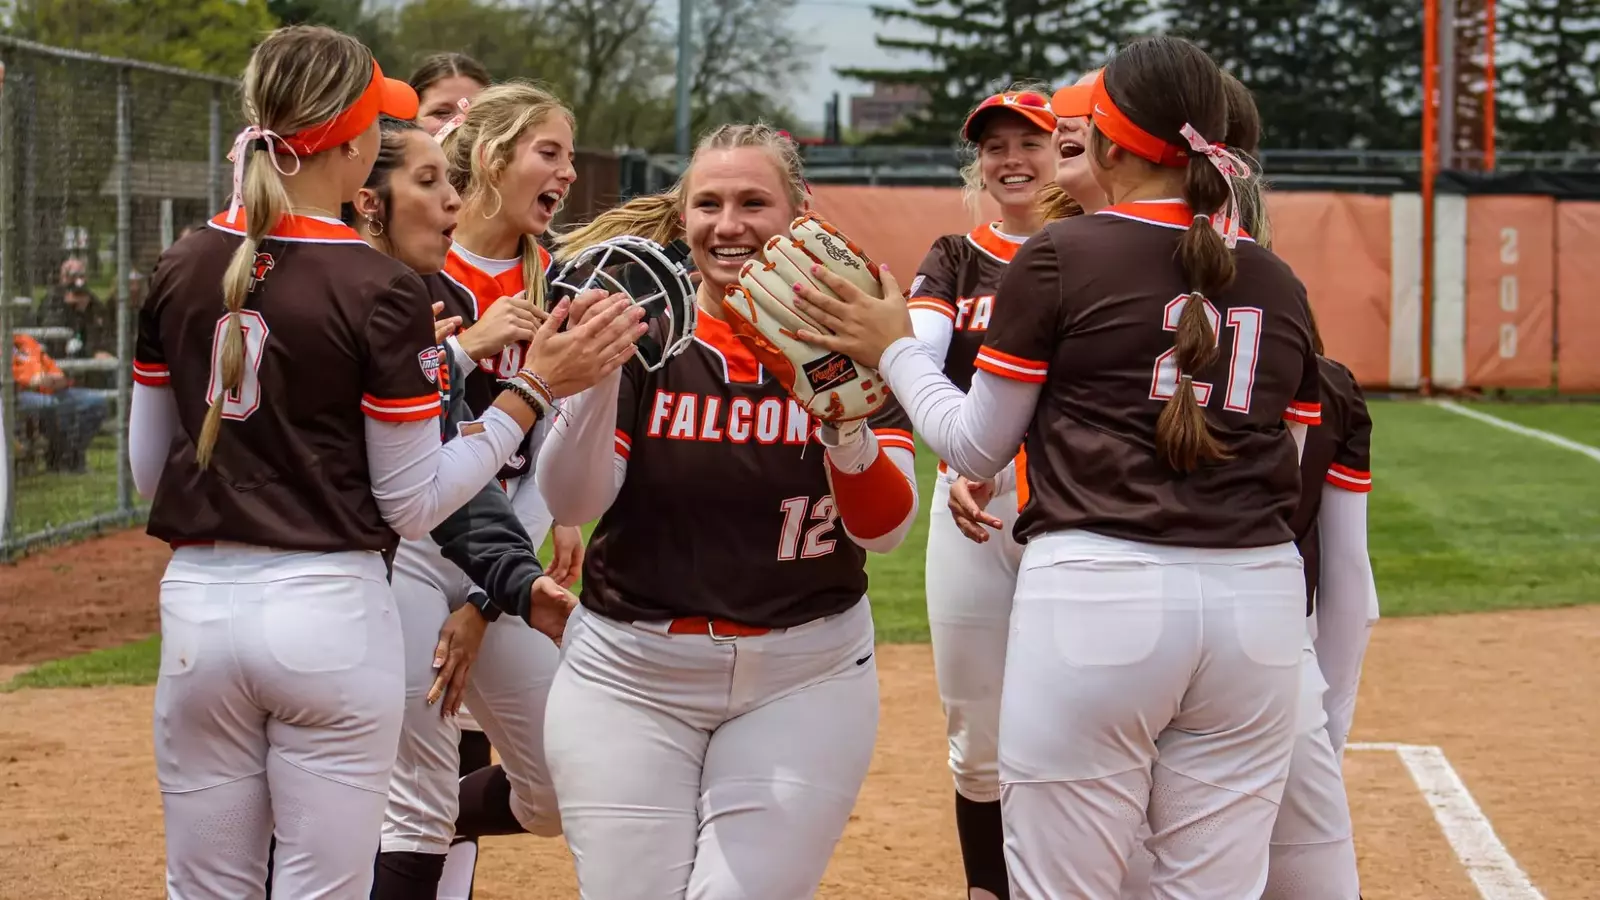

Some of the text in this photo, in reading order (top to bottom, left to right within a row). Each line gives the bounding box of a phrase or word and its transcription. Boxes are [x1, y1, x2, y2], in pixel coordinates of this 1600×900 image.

[815, 233, 860, 270] Rawlings
[1499, 227, 1519, 358] 200
[206, 309, 270, 421] 0
[1149, 293, 1263, 414] 21
[647, 389, 823, 444] FALCON
[777, 495, 837, 561] 12
